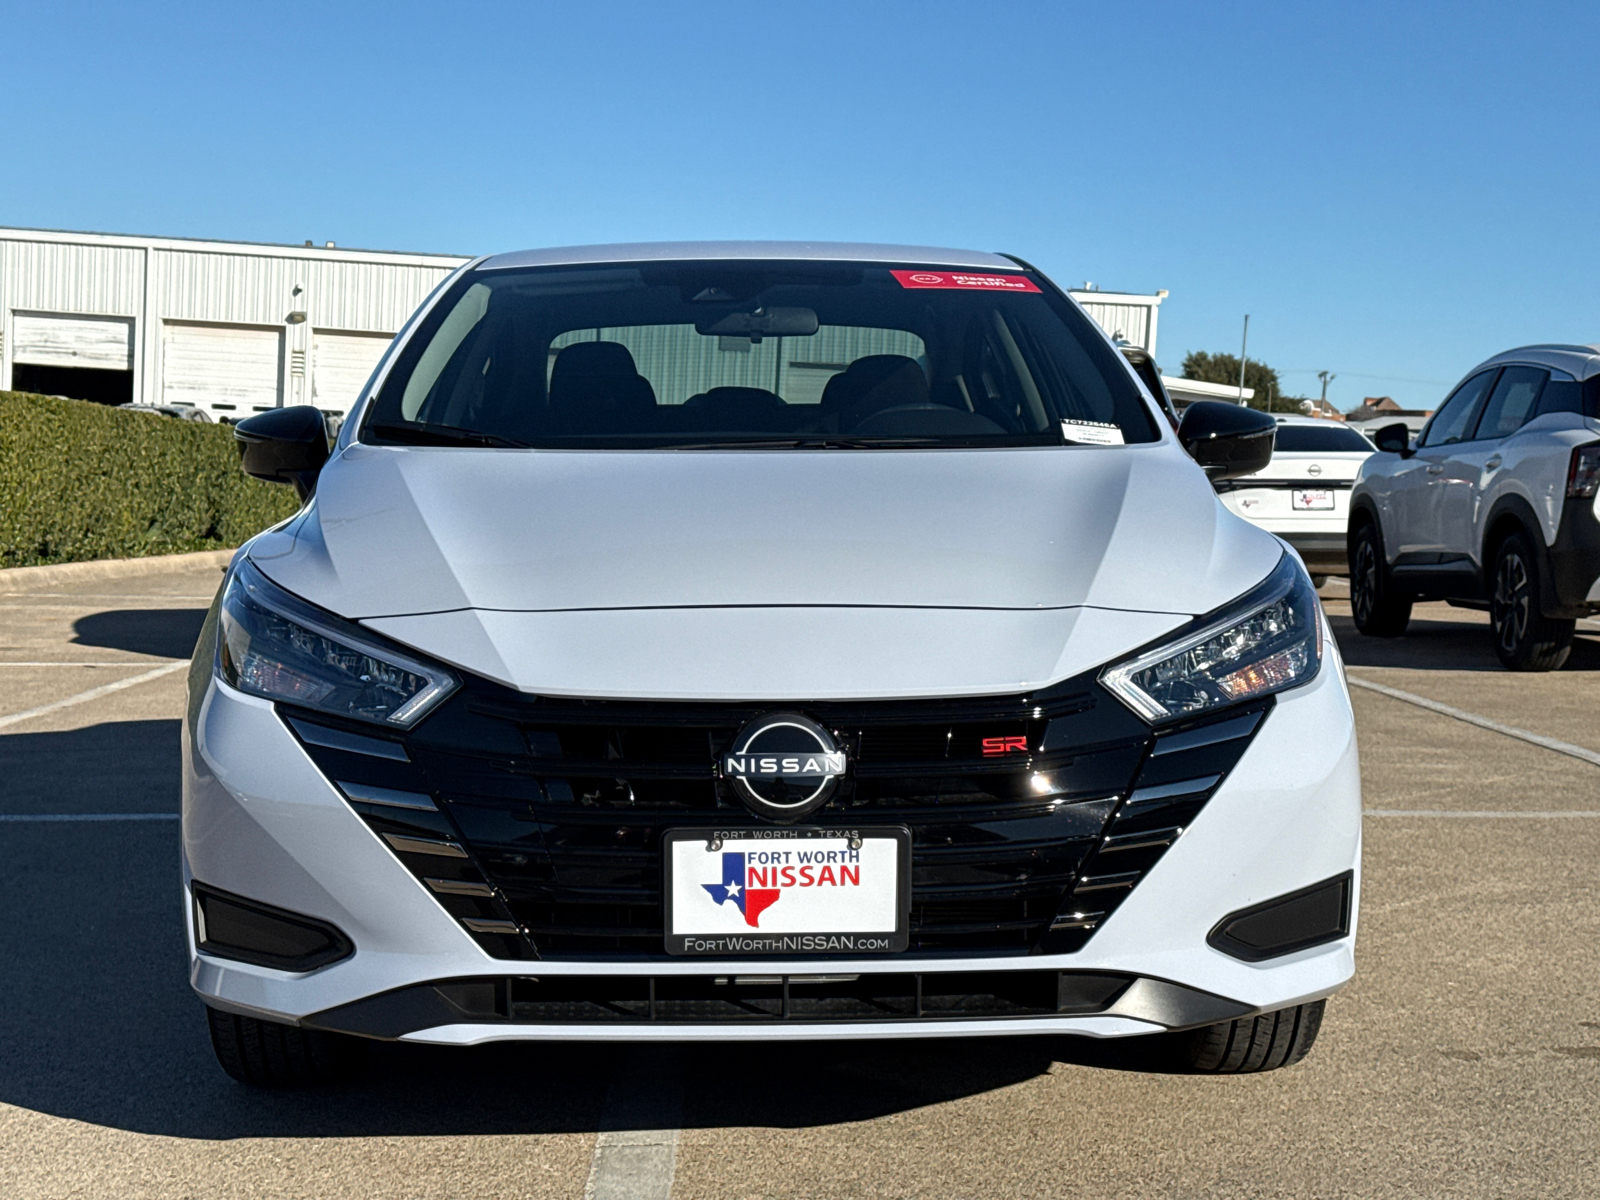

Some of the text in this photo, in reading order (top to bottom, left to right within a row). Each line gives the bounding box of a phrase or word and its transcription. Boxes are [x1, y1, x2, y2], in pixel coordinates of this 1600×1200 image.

[952, 275, 1006, 283] Nissan
[956, 280, 1025, 288] Certified
[982, 736, 1027, 753] SR
[727, 757, 843, 774] NISSAN
[713, 830, 859, 839] FORT WORTH TEXAS
[748, 850, 860, 865] FORT WORTH
[748, 865, 860, 888] NISSAN
